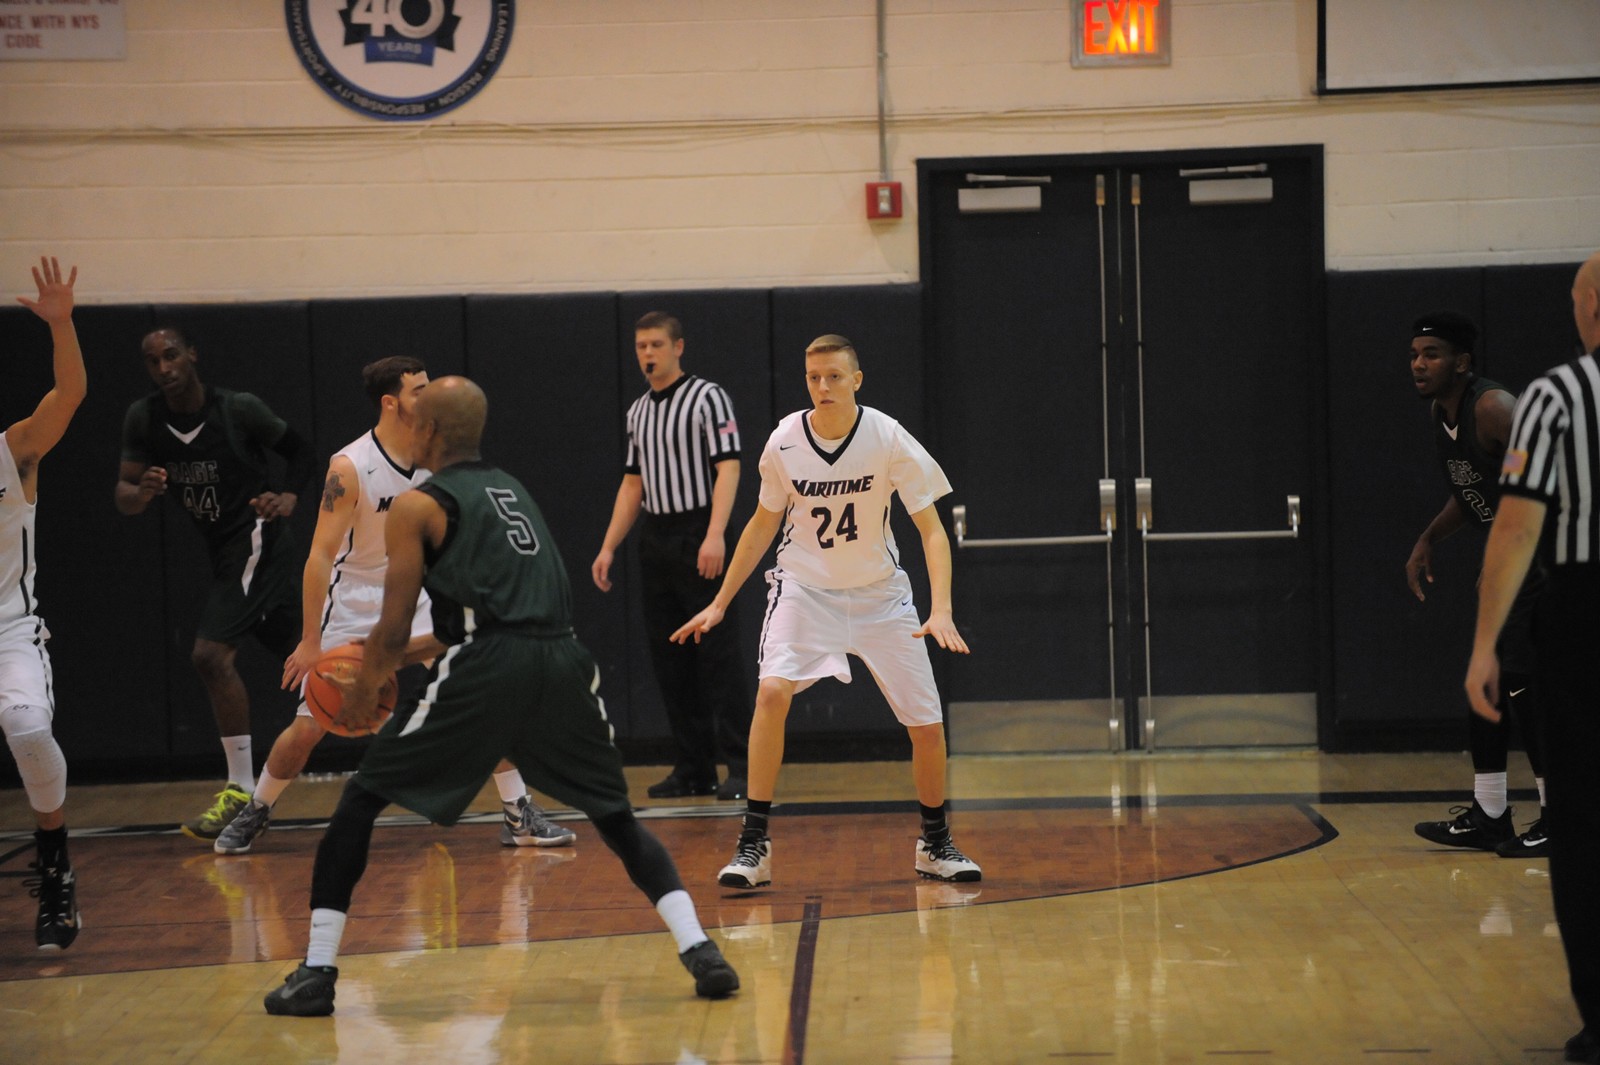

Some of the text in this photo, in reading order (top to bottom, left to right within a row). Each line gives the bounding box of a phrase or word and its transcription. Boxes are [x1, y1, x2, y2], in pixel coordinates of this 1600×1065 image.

[31, 15, 66, 29] WITH
[71, 15, 101, 30] NYS
[351, 0, 445, 39] 40
[1084, 0, 1159, 54] EXIT
[6, 34, 43, 49] CODE
[377, 42, 422, 54] YEARS
[438, 72, 483, 106] PASSION
[184, 486, 220, 522] 44
[792, 475, 874, 498] MARITIME
[485, 487, 540, 555] 5
[811, 503, 858, 549] 24
